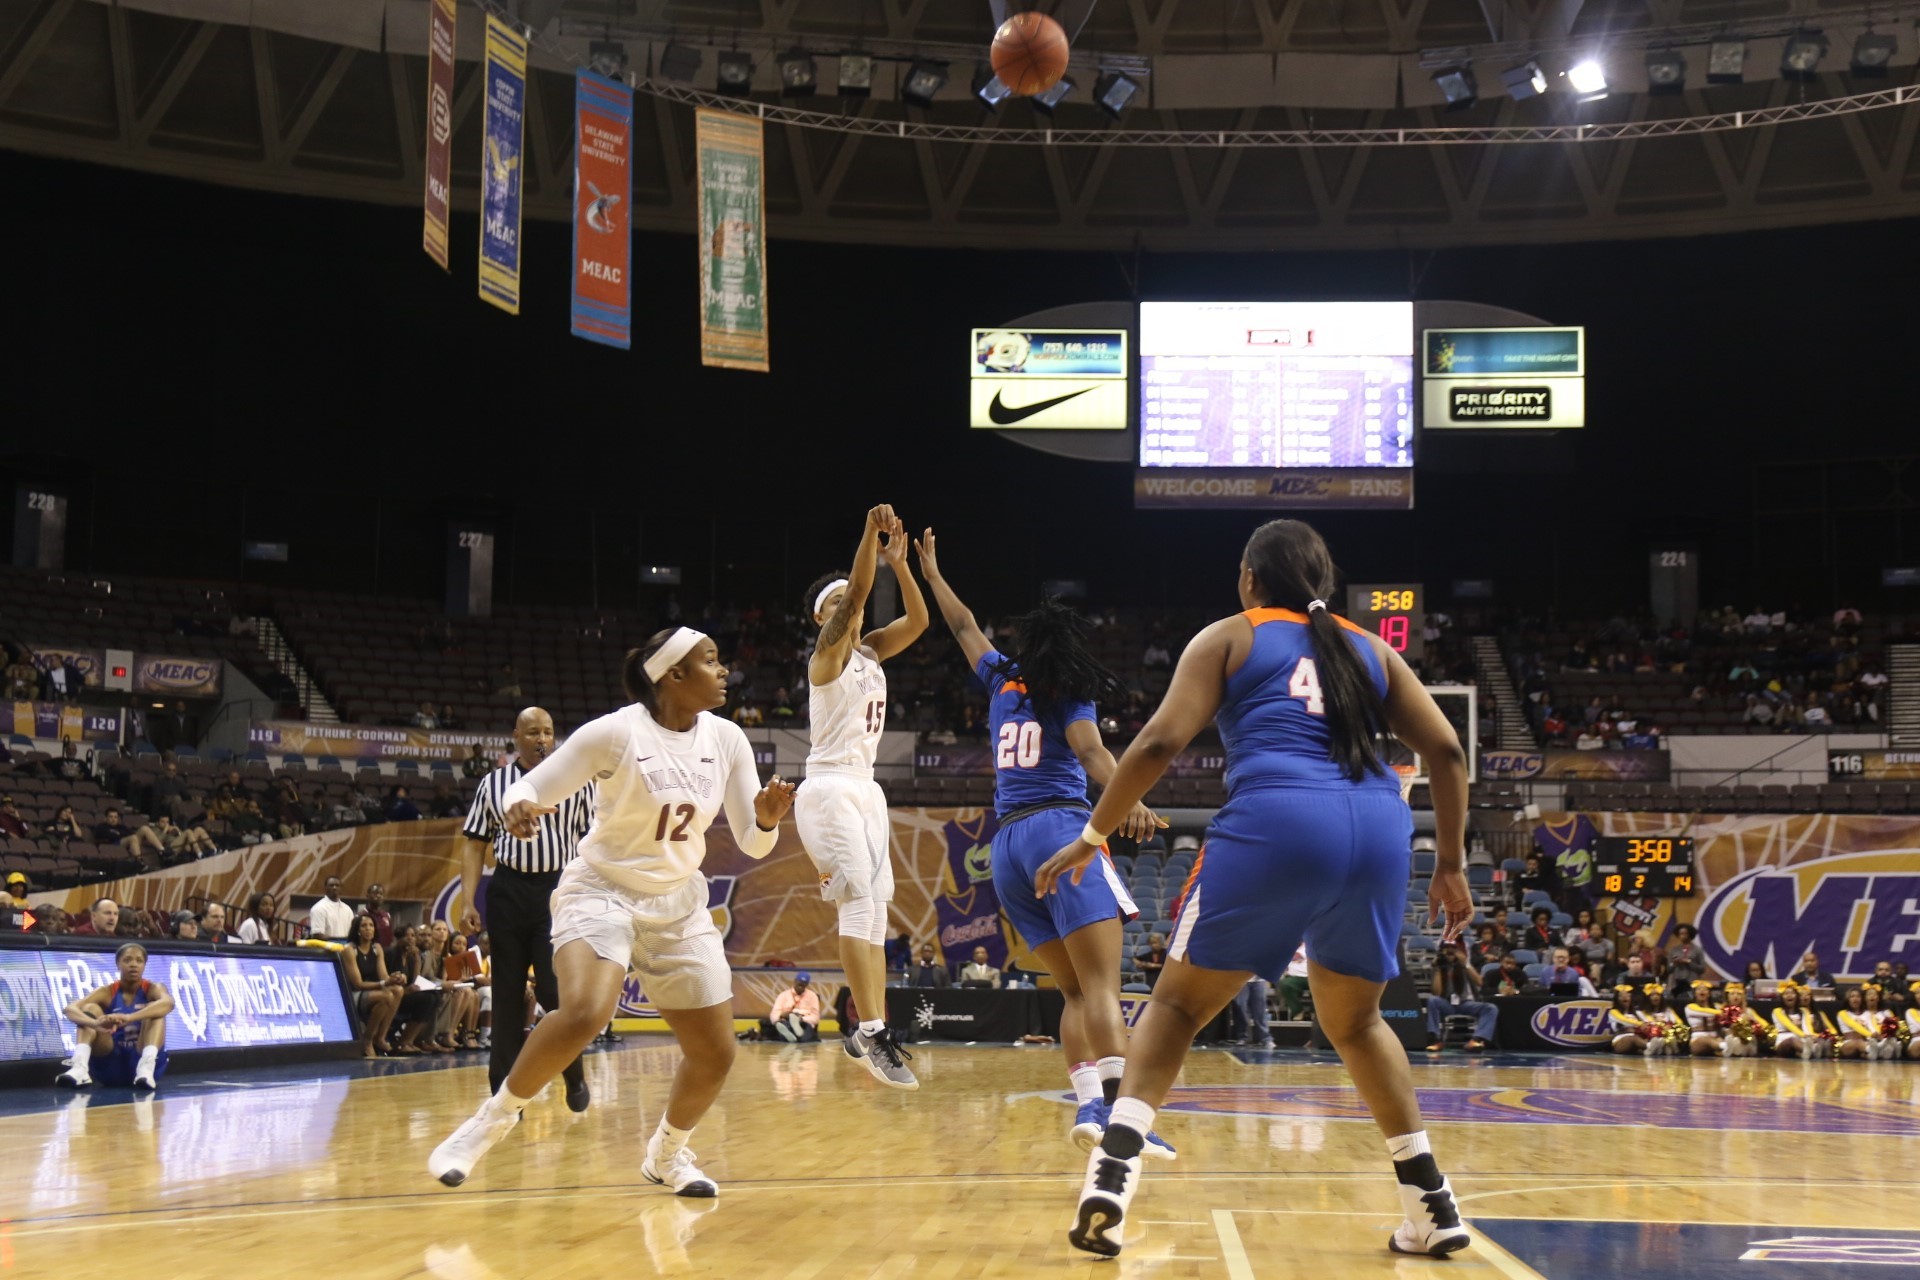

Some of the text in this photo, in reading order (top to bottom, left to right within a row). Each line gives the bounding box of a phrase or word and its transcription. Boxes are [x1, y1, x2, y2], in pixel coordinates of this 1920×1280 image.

[584, 124, 624, 146] DELAWARE
[581, 144, 626, 167] UNIVERSITY
[592, 138, 614, 154] STATE
[429, 174, 447, 205] MEAC
[486, 212, 516, 246] MEAC
[582, 259, 622, 284] MEAC
[710, 290, 756, 309] MEAC
[1455, 389, 1547, 406] PRIORITY
[1457, 405, 1546, 416] AUTOMOTIVE
[1144, 476, 1403, 497] WELCOME MEAC FANS
[28, 491, 55, 511] 228
[459, 531, 483, 548] 227
[1661, 550, 1687, 567] 224
[1370, 590, 1414, 611] 3:58
[151, 663, 210, 681] MEAC
[1288, 656, 1325, 715] 4
[91, 716, 116, 731] 120
[866, 701, 885, 734] 15
[250, 729, 273, 742] 119
[305, 727, 408, 743] BETHUNE-COOKMAN
[997, 721, 1042, 768] 20
[381, 744, 417, 757] COPPIN
[421, 746, 452, 758] STATE
[756, 752, 774, 764] 18
[919, 755, 942, 767] 117
[1202, 757, 1224, 768] 117
[1830, 755, 1863, 774] 116
[655, 803, 696, 842] 12
[1626, 839, 1673, 863] 3:58
[1604, 874, 1692, 893] 18 2 14
